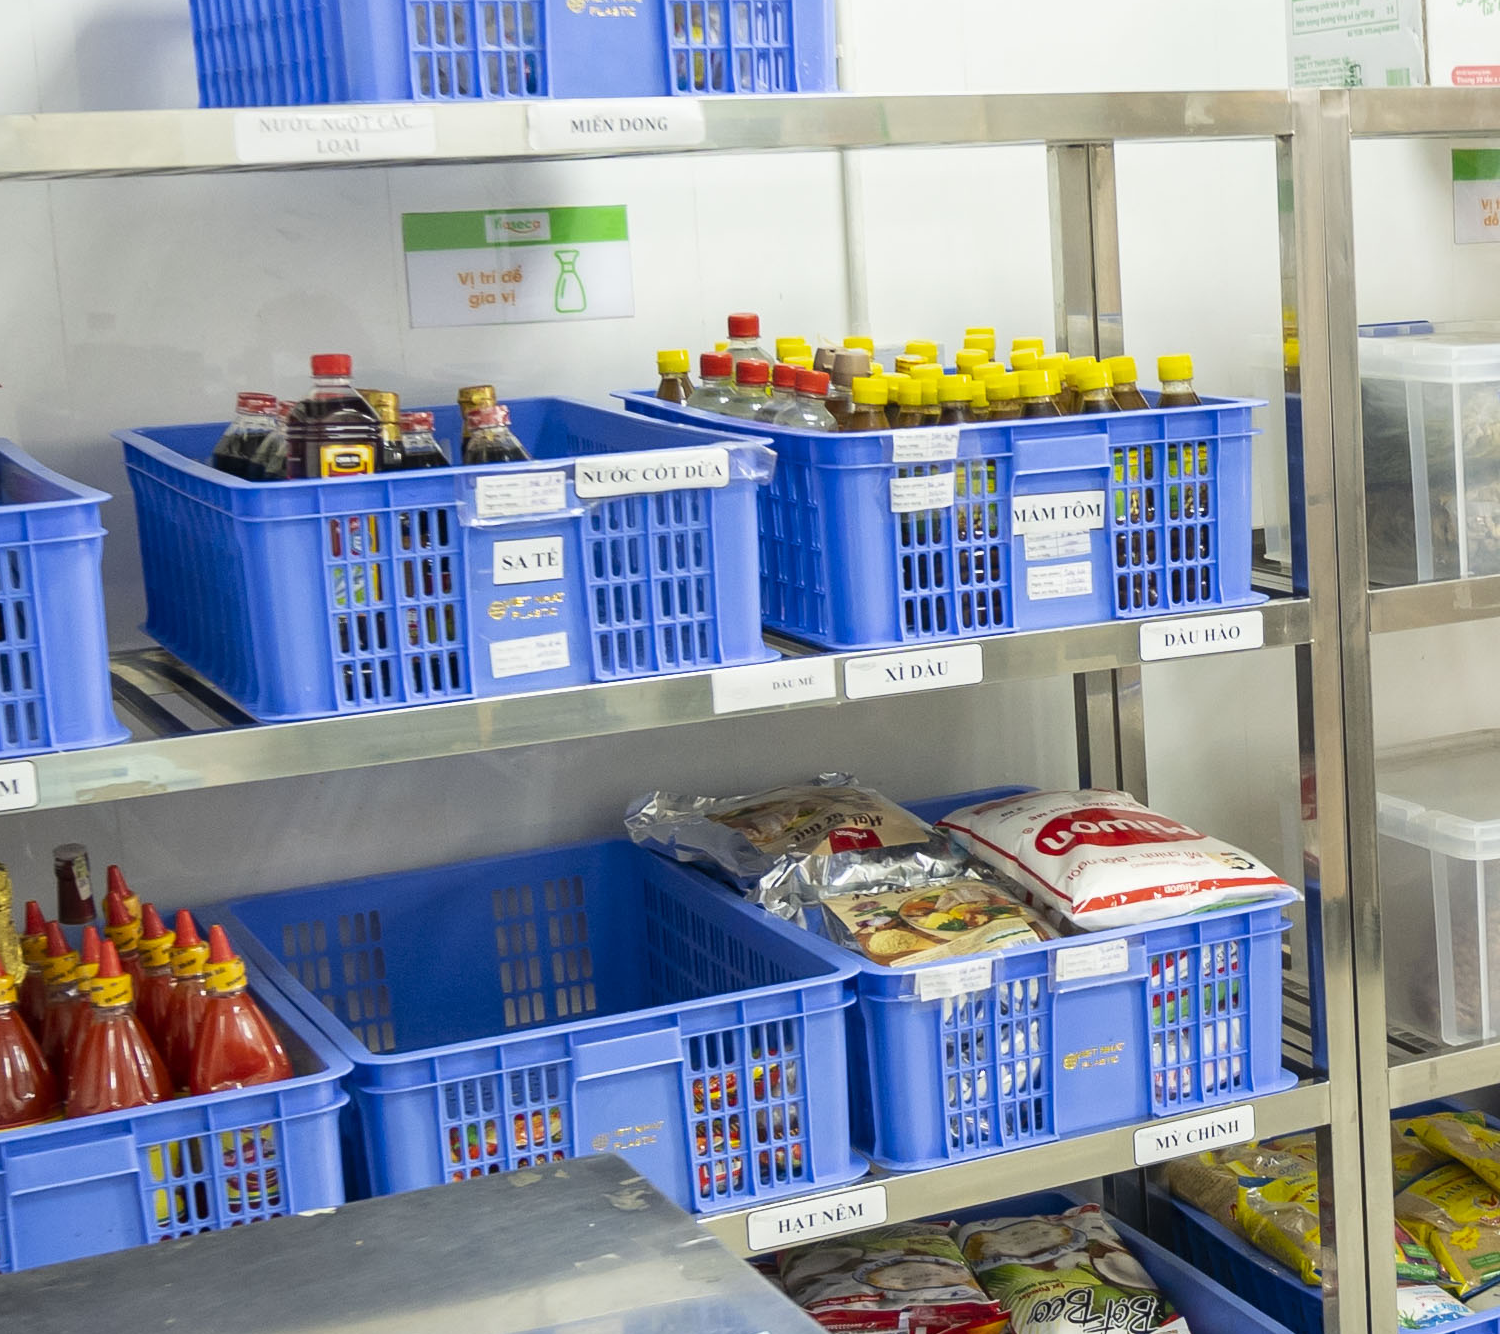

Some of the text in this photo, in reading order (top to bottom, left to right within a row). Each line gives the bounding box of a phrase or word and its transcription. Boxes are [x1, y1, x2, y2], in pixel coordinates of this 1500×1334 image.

[620, 116, 668, 132] DONG
[1481, 198, 1493, 214] Vị
[457, 271, 474, 289] Vị
[468, 290, 516, 308] gia vị
[583, 464, 638, 484] NƯỚC
[685, 458, 722, 478] DỪA
[1061, 500, 1102, 519] TÔM
[501, 554, 528, 571] SA
[1204, 625, 1242, 644] HÀO
[884, 664, 907, 684] XÌ
[1040, 817, 1198, 851] Miwon
[1164, 880, 1199, 895] Miwon
[1186, 1118, 1240, 1144] CHÍNH
[778, 1203, 864, 1234] HẠT NÊM
